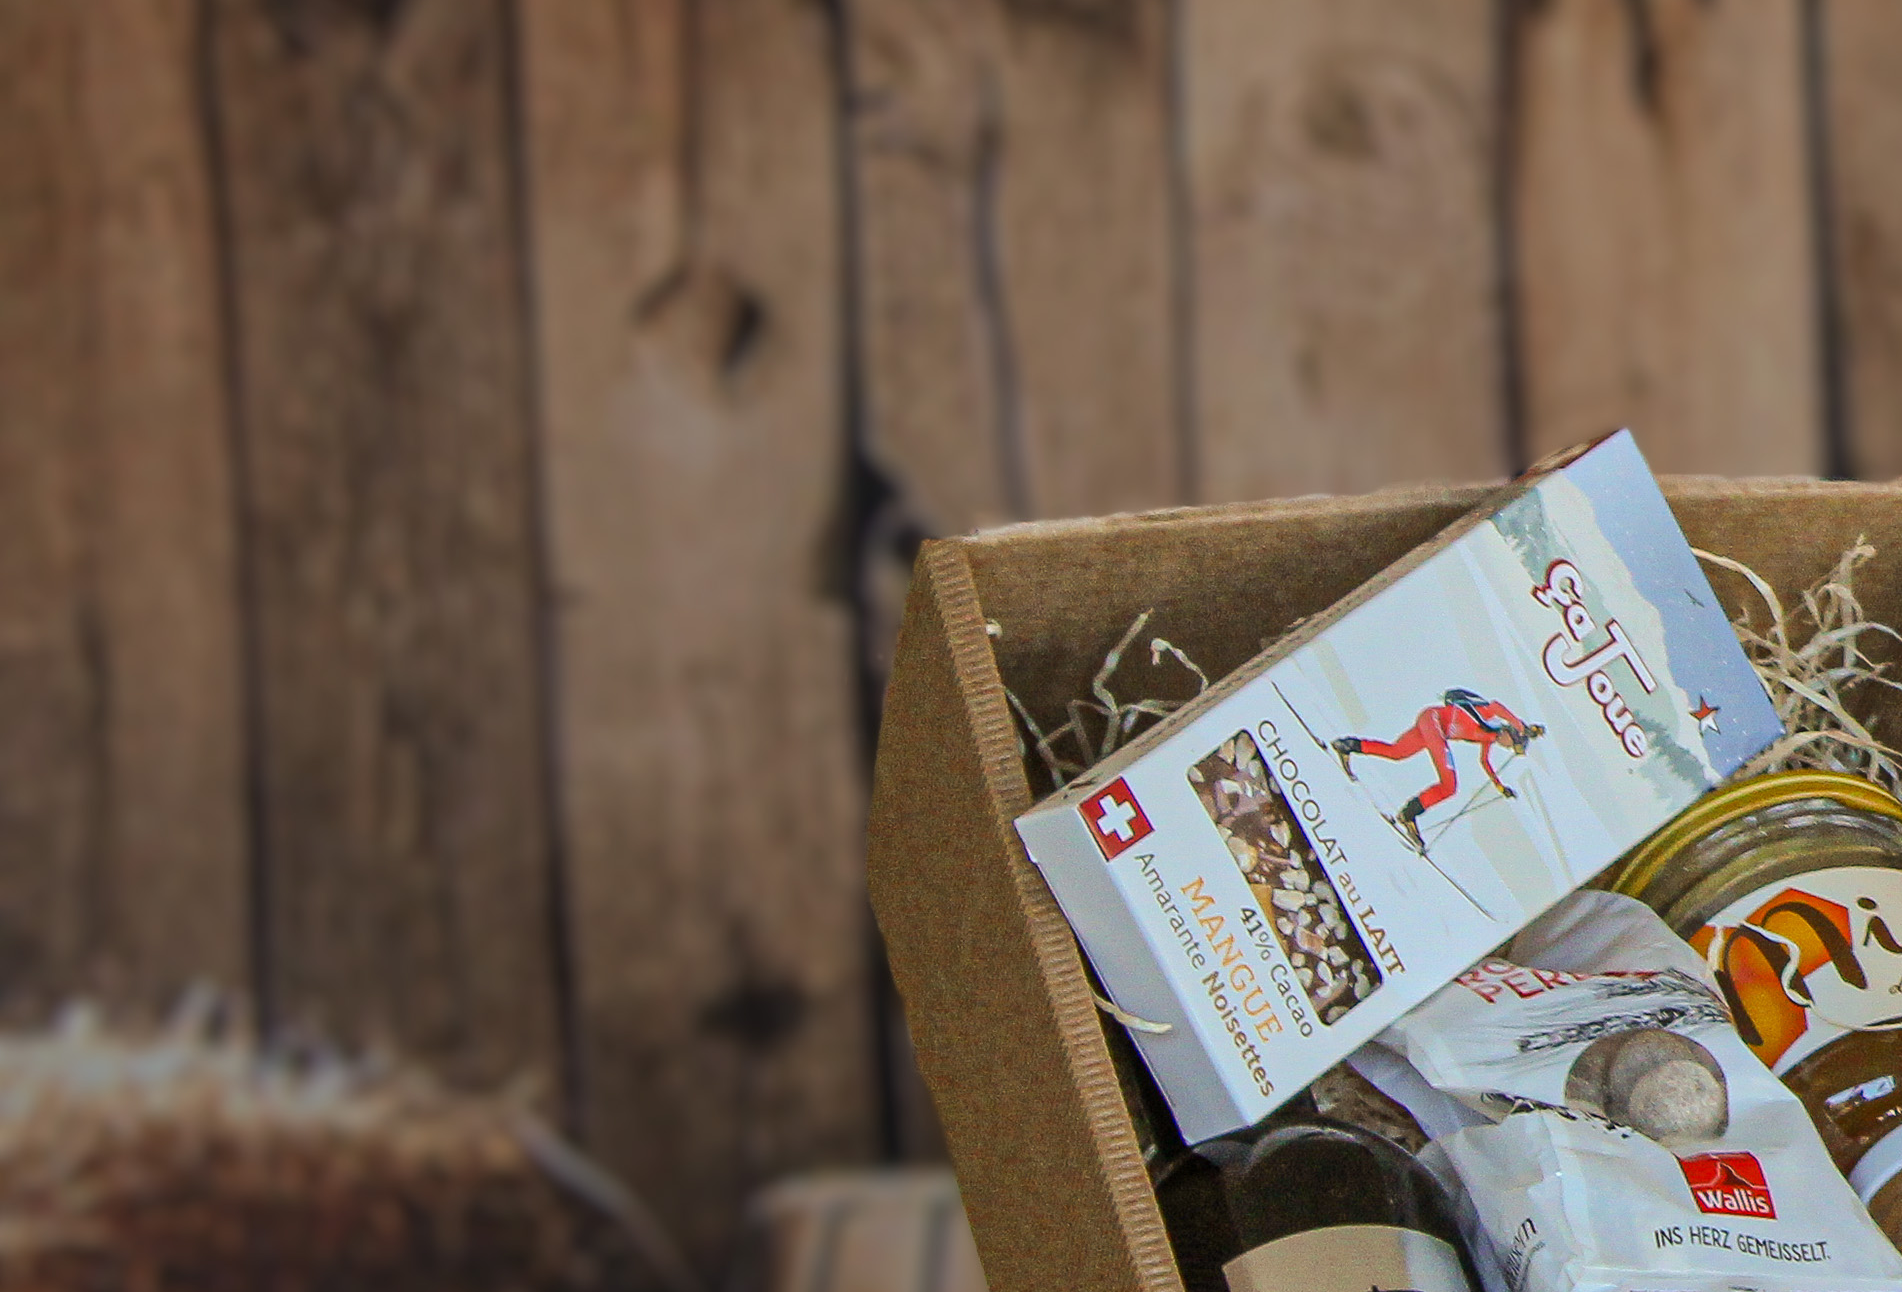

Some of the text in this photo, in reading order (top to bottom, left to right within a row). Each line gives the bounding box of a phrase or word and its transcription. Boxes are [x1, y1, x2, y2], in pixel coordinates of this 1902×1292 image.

[1542, 618, 1658, 759] Joue
[1257, 719, 1407, 977] CHOCOLAT au LAIT
[1133, 852, 1276, 1099] Amarante Noisettes
[1180, 876, 1284, 1044] MANGUE
[1239, 906, 1315, 1039] 41% Cacao
[1654, 1225, 1832, 1264] INS HERZ GEMEISSELT.
[1696, 1187, 1770, 1215] Wallis
